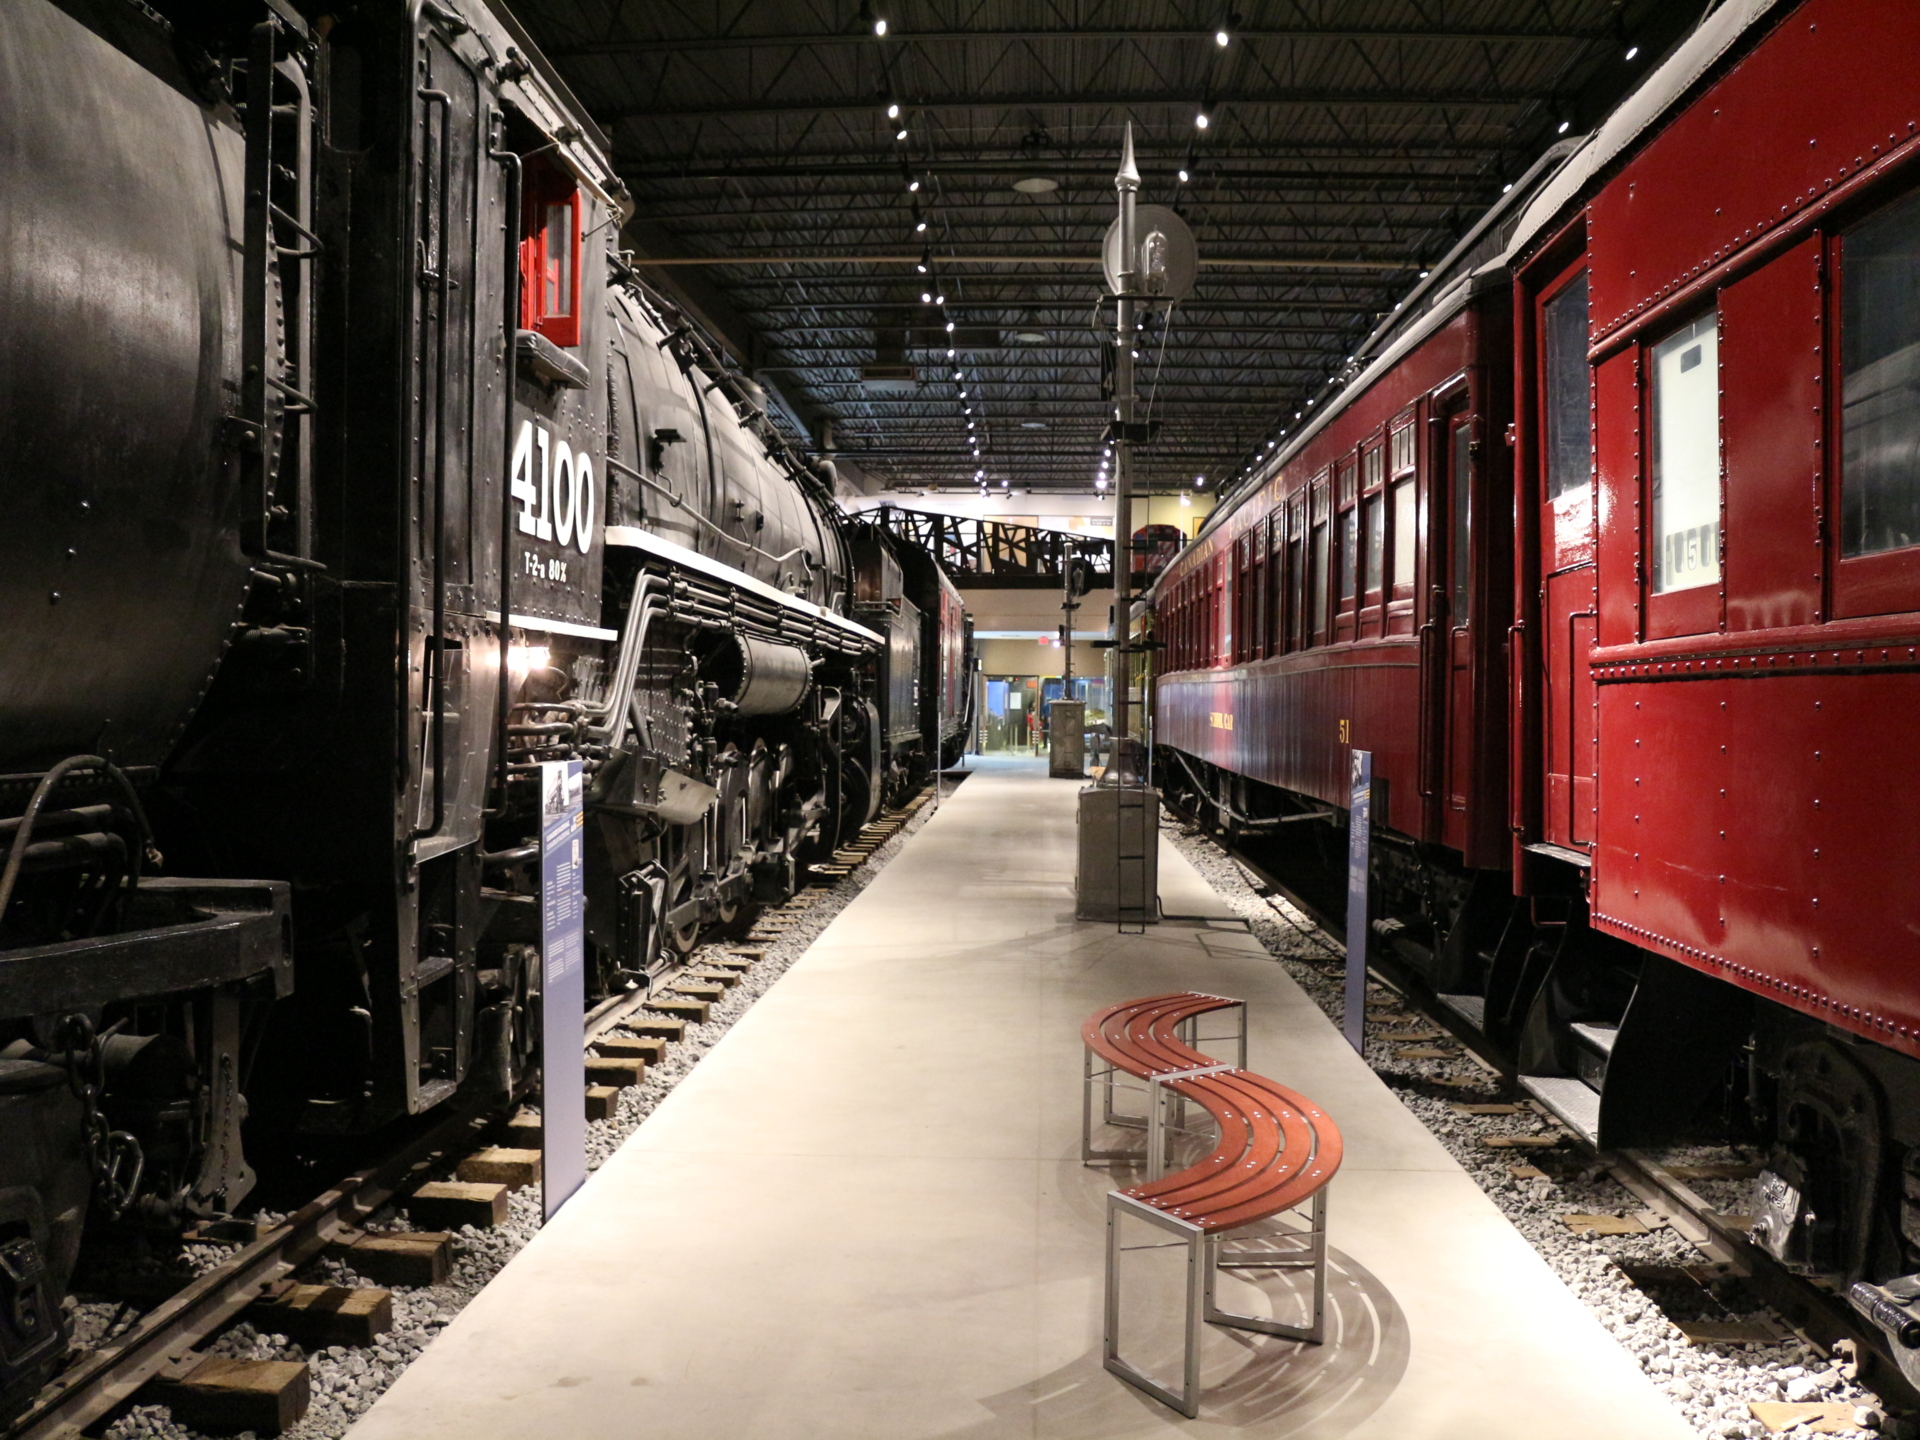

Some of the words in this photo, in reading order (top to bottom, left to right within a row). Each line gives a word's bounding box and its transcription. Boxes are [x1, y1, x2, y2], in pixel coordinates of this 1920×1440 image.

[511, 419, 595, 554] 4100
[1179, 537, 1214, 577] CANADIAN
[1228, 475, 1283, 539] PACIFIC
[548, 558, 567, 583] 80%
[1339, 719, 1350, 744] 51
